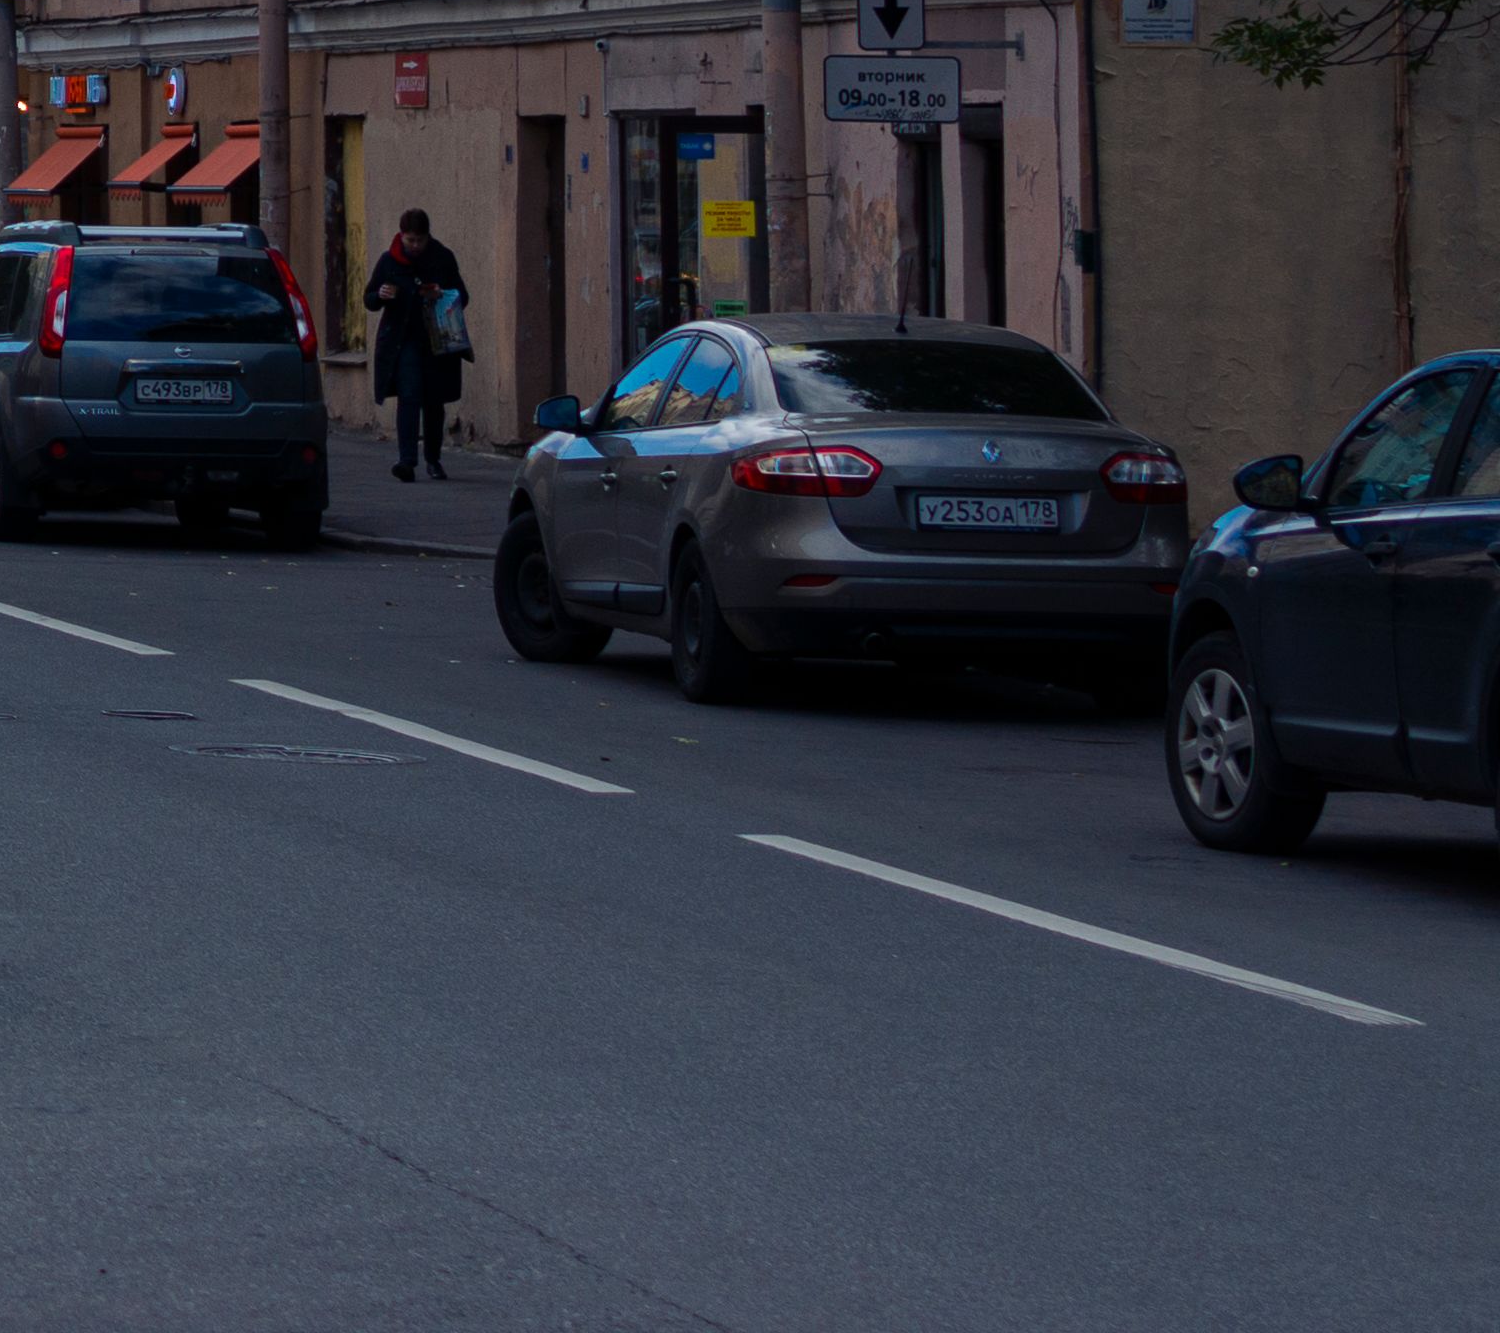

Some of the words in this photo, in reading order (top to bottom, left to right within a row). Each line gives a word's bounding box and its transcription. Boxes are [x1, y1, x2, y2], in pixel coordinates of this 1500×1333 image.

[858, 72, 925, 85] вторник
[205, 381, 229, 394] 178
[1019, 501, 1054, 518] 178
